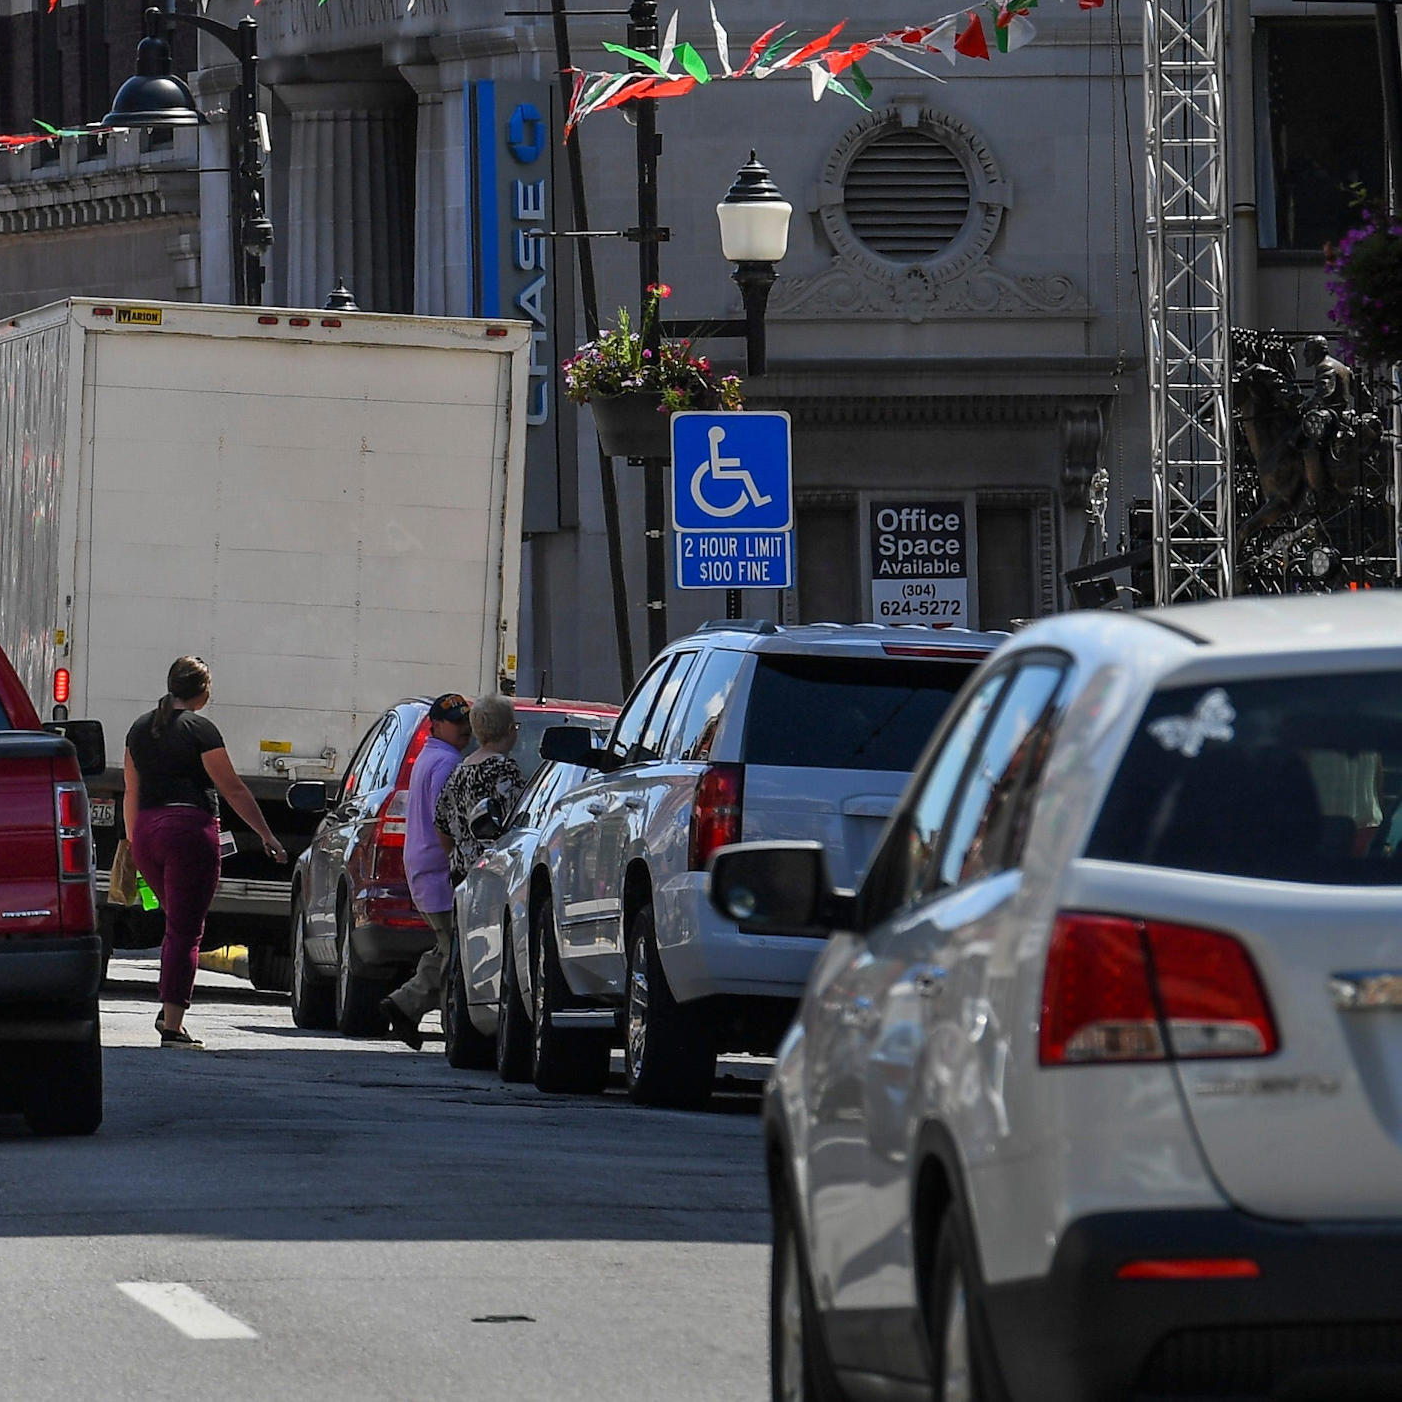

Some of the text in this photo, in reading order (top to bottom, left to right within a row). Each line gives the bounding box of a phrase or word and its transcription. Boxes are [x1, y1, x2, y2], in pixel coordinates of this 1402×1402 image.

[513, 177, 548, 427] CHASE
[118, 309, 158, 322] MARION
[877, 508, 960, 532] Office
[684, 537, 782, 557] 2 HOUR LIMIT
[878, 533, 961, 560] Space
[700, 561, 770, 582] $100 FINE
[879, 559, 961, 574] Available
[902, 584, 936, 598] (304)
[880, 600, 961, 616] 624-5272
